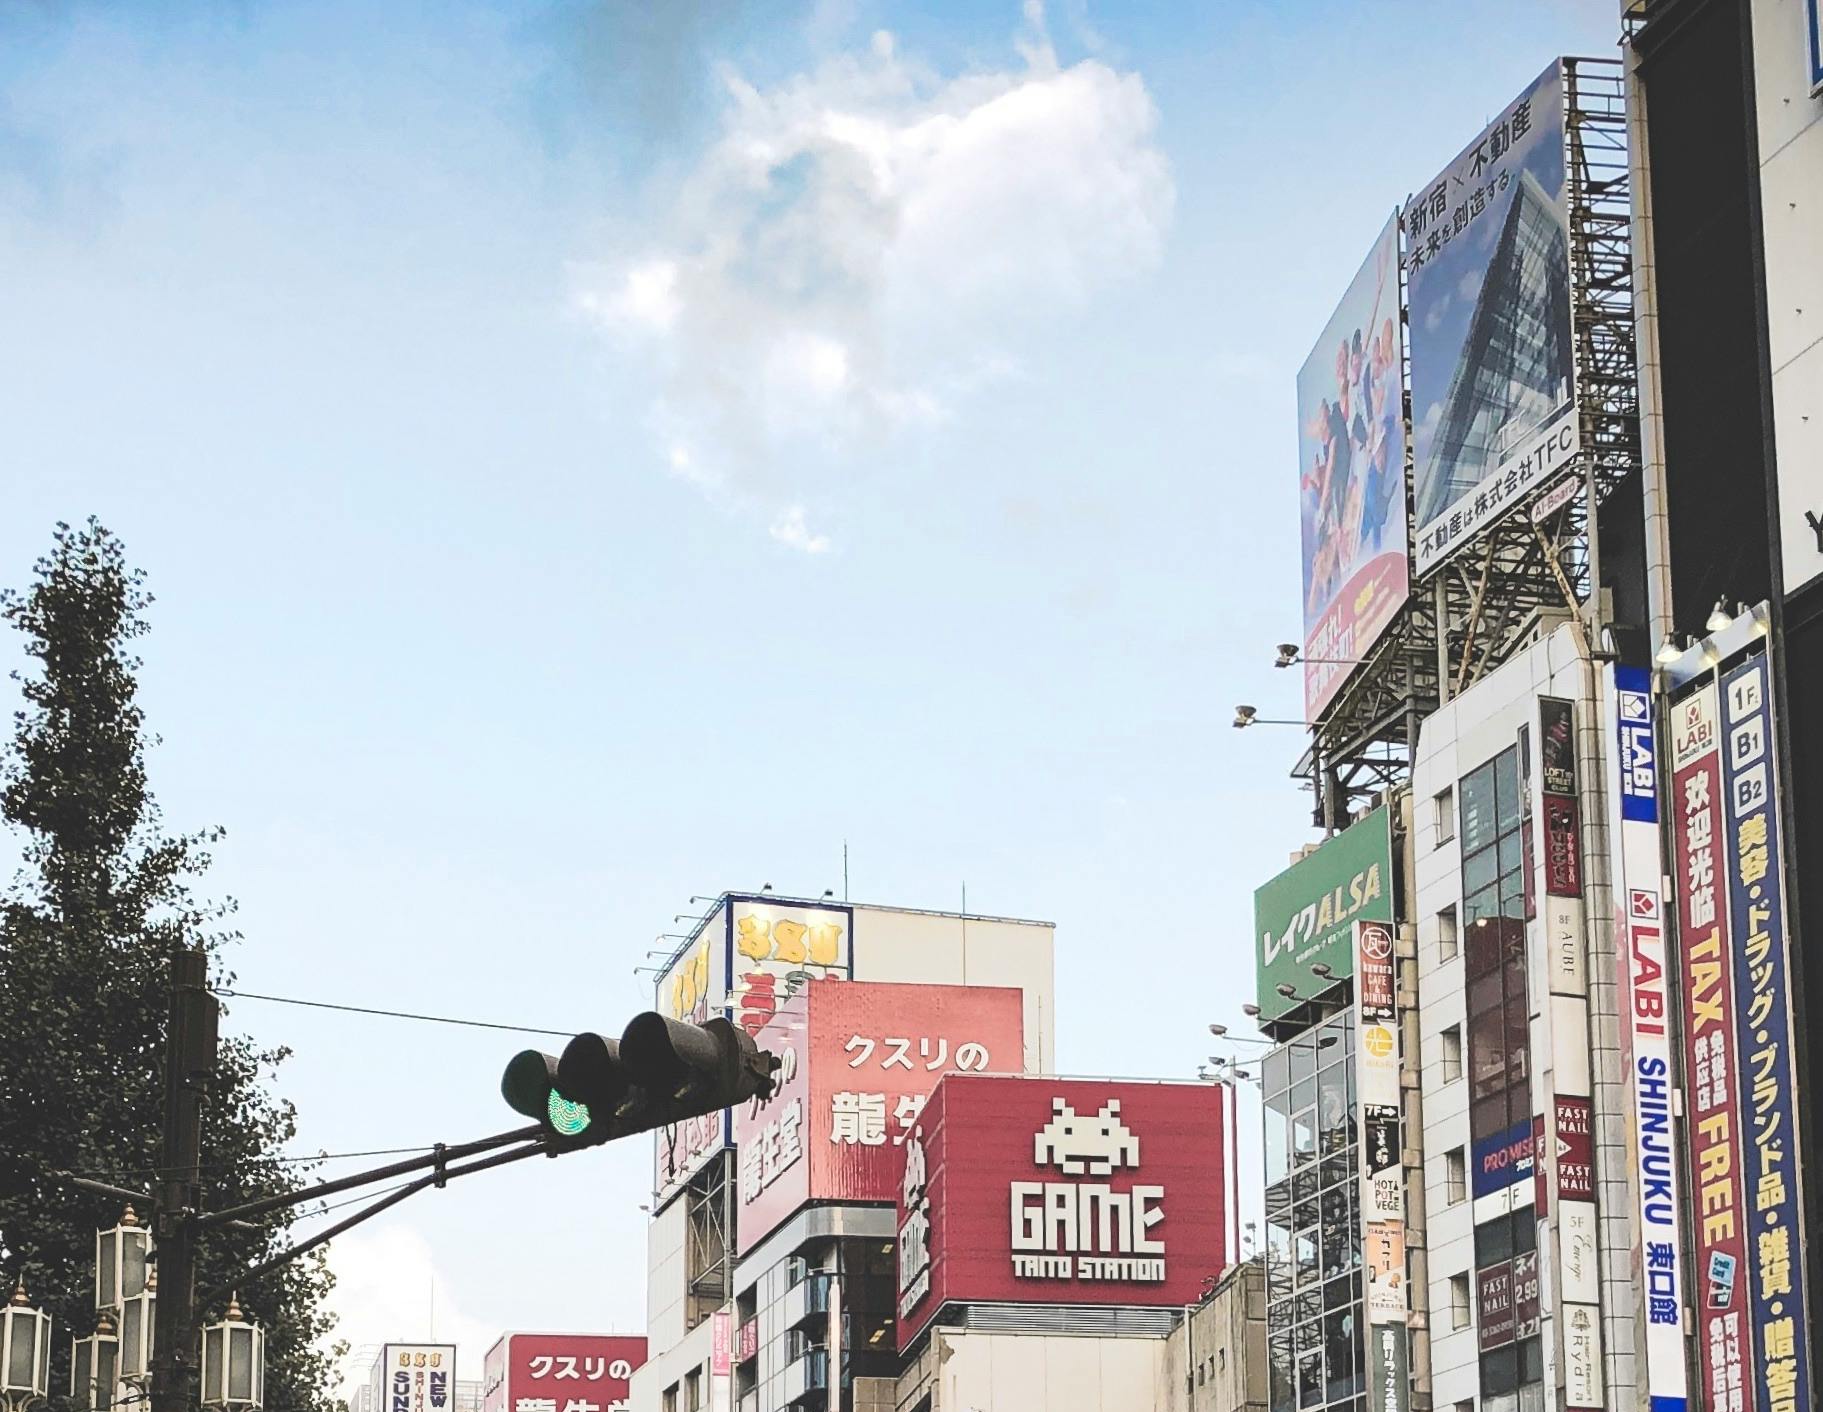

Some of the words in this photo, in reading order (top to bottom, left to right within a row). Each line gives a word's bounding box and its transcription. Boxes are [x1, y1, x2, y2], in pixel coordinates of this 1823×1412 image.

[1677, 720, 1712, 754] LABI
[1737, 732, 1760, 759] B1
[1544, 767, 1565, 778] LOFT
[1631, 727, 1655, 798] LABI
[1738, 779, 1763, 808] B2
[1367, 975, 1388, 986] CAFE
[1631, 925, 1665, 1037] LABI
[1689, 926, 1725, 1035] TAX
[1363, 993, 1393, 1005] DINING
[844, 1034, 990, 1072] クスリの
[1365, 1105, 1382, 1117] 7F
[1557, 1107, 1589, 1120] FAST
[1558, 1120, 1590, 1134] NAIL
[1638, 1056, 1674, 1226] SHINJUKU
[1559, 1164, 1590, 1177] FAST
[1698, 1110, 1734, 1248] FREE
[1560, 1177, 1591, 1192] NAIL
[1010, 1181, 1166, 1254] GAME
[1376, 1200, 1400, 1211] VEGE
[1011, 1255, 1072, 1280] TAITO
[1077, 1256, 1166, 1282] STATION
[1483, 1277, 1508, 1296] FAST
[1647, 1241, 1679, 1326] 東口館
[1483, 1296, 1510, 1314] NAIL
[529, 1356, 631, 1381] クスリの
[1571, 1335, 1585, 1401] Rydia
[430, 1371, 447, 1408] NEW
